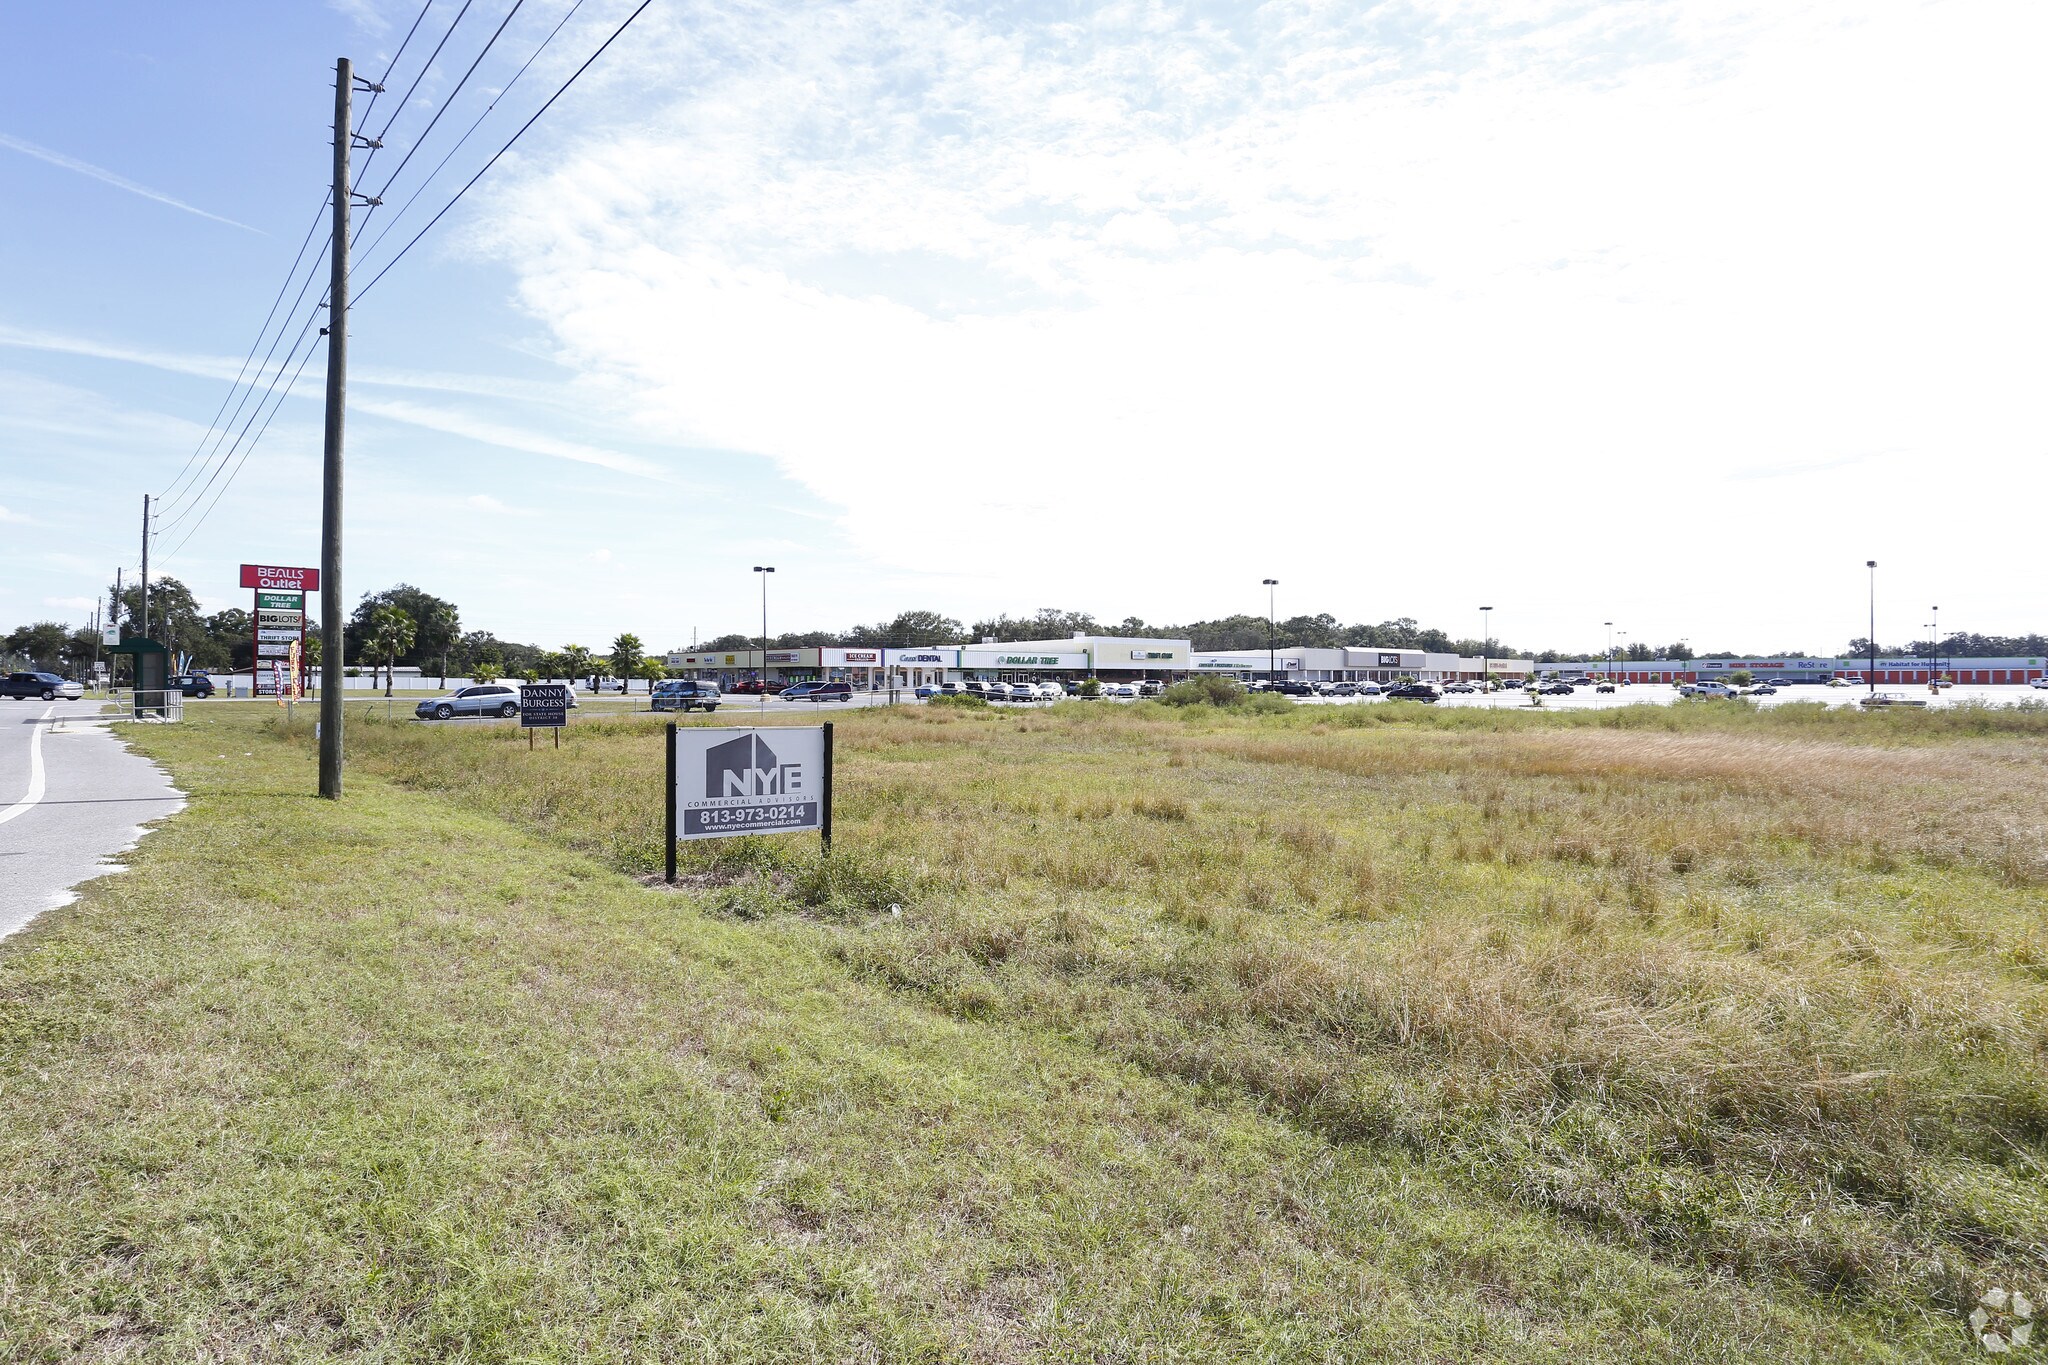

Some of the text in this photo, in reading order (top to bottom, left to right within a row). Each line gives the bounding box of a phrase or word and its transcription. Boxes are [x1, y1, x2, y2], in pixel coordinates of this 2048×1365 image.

[257, 567, 304, 579] BEALLS
[260, 578, 302, 589] Outlet
[917, 654, 943, 663] DENTAL
[1006, 656, 1059, 664] DOLLAR TREE
[522, 688, 564, 698] DANNY
[522, 698, 564, 708] BURGESS
[723, 766, 802, 797] NYE
[687, 795, 814, 808] COMMERCIAL ADVISORS
[700, 805, 806, 824] 813-973-0214
[704, 818, 801, 831] www.nyecommercial.com
